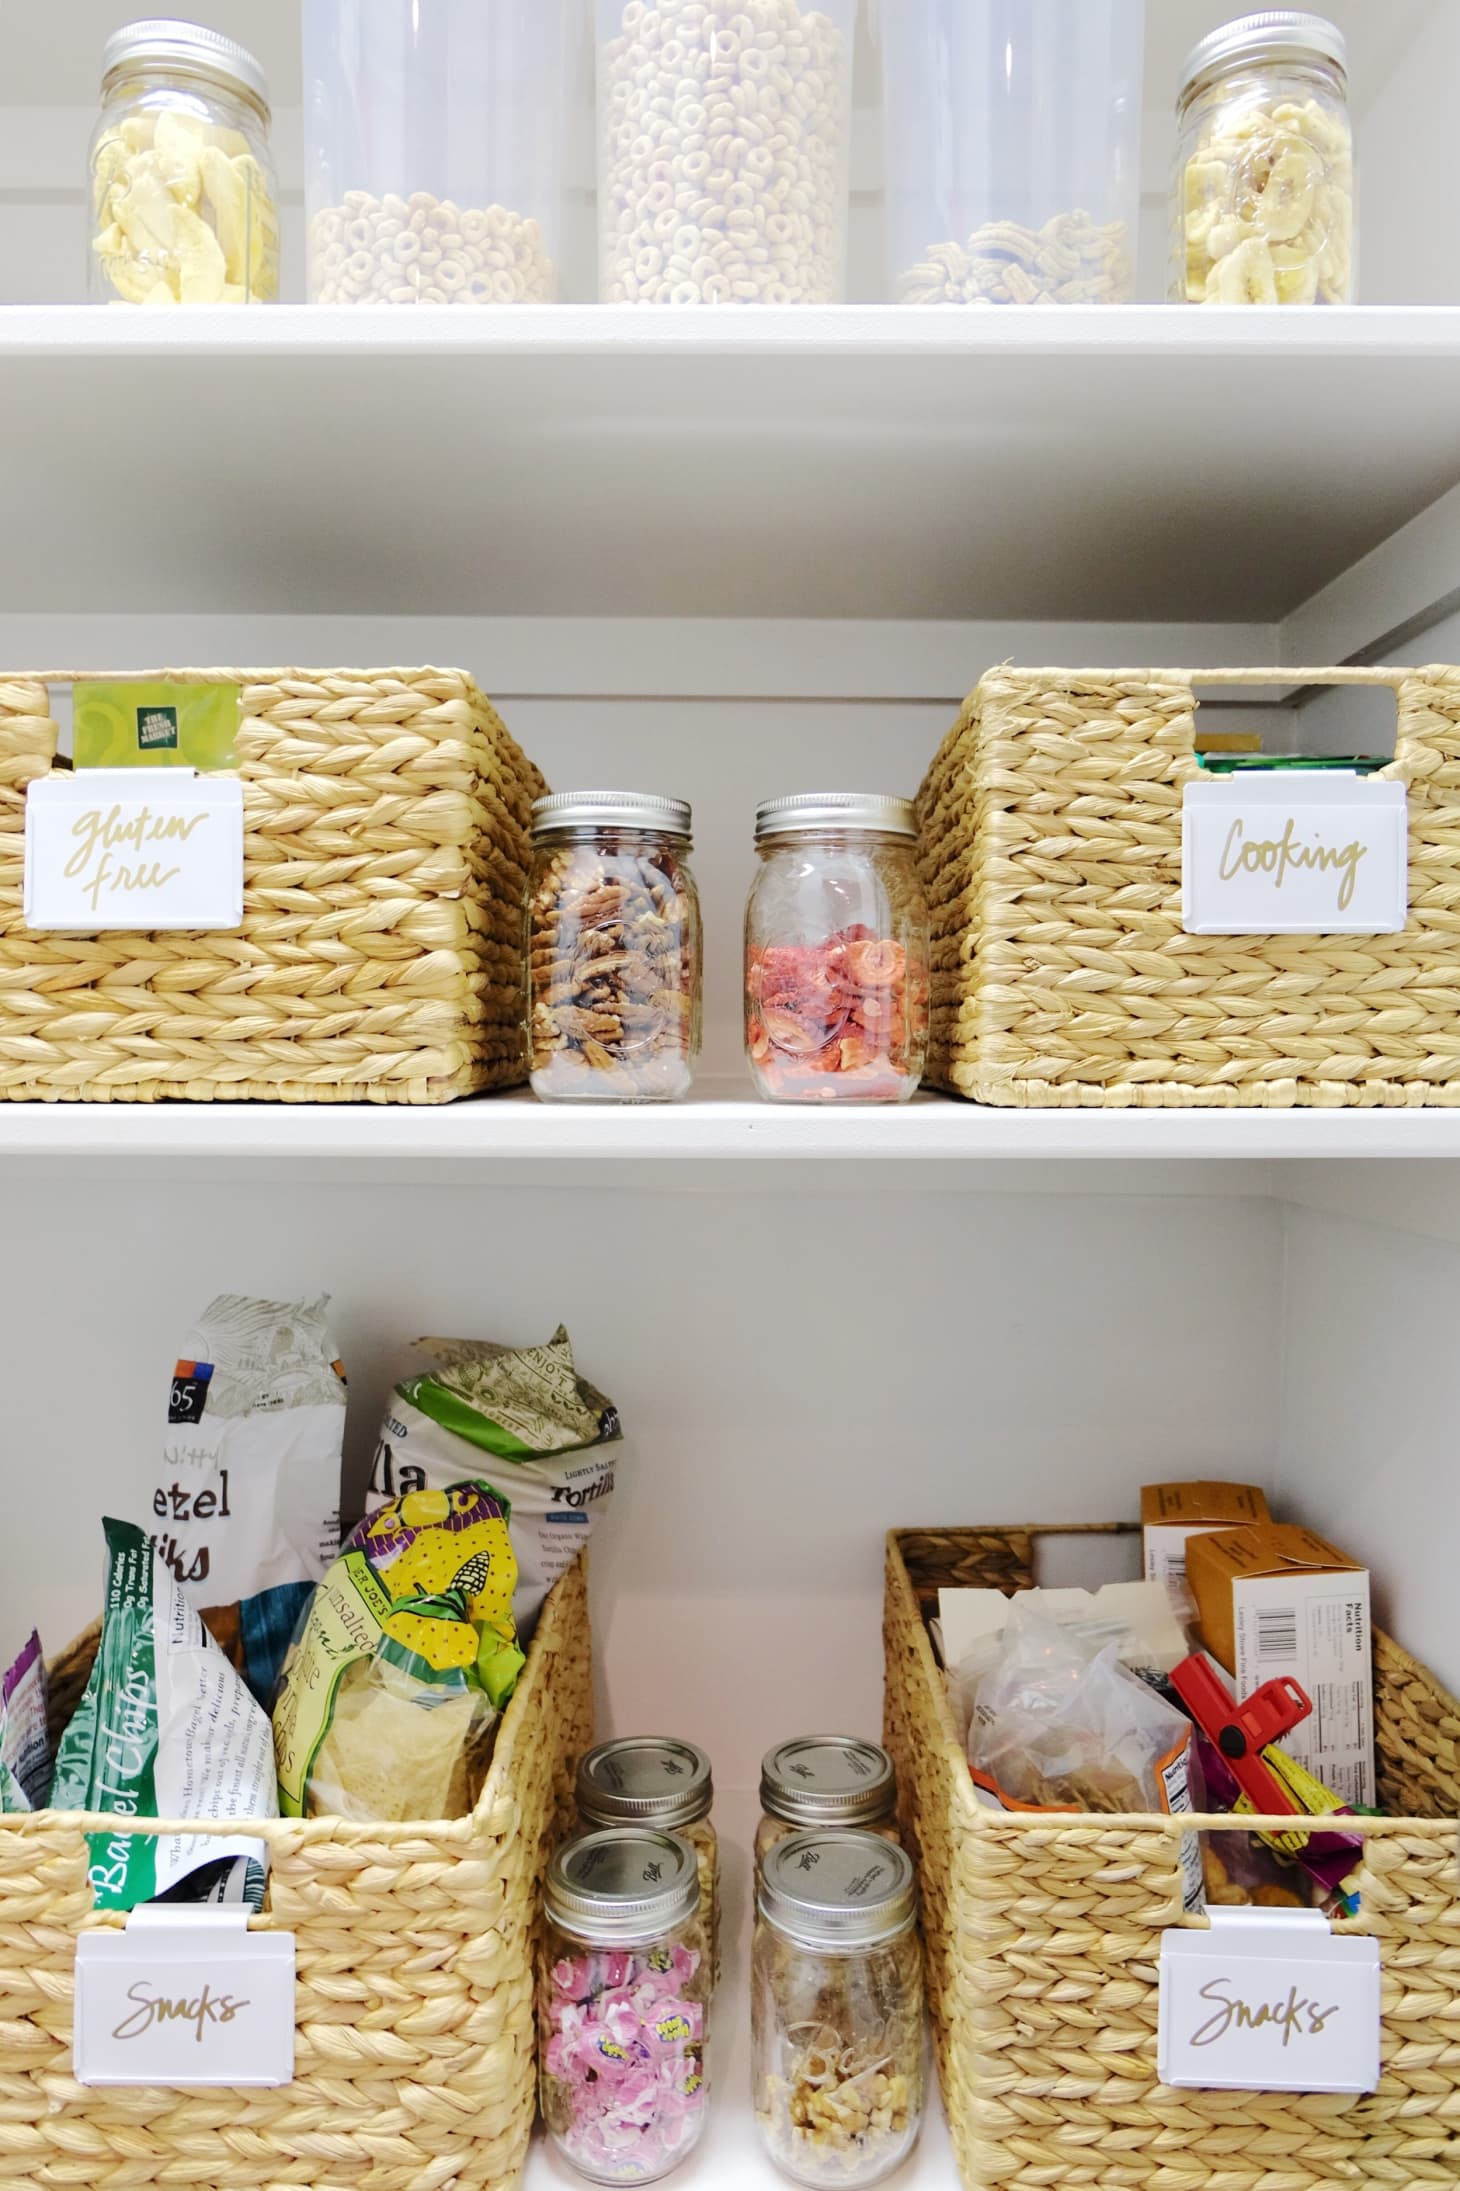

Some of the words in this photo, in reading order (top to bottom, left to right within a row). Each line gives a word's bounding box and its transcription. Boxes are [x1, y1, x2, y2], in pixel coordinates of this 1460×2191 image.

[64, 804, 210, 878] gluten
[81, 851, 181, 911] free
[1219, 817, 1367, 912] Cooking
[113, 1552, 126, 1587] Calories
[129, 1548, 138, 1566] Fat
[138, 1550, 150, 1594] Saturated
[125, 1569, 137, 1591] Trans
[110, 1590, 121, 1609] 110
[124, 1595, 136, 1609] 0g
[137, 1595, 149, 1609] 0g
[364, 1585, 389, 1617] JOE'S
[1345, 1602, 1353, 1634] Facts
[1354, 1601, 1363, 1652] Nutrition
[642, 1861, 664, 1883] Ball
[112, 1980, 251, 2043] Snacks
[1189, 1977, 1340, 2048] Snacks
